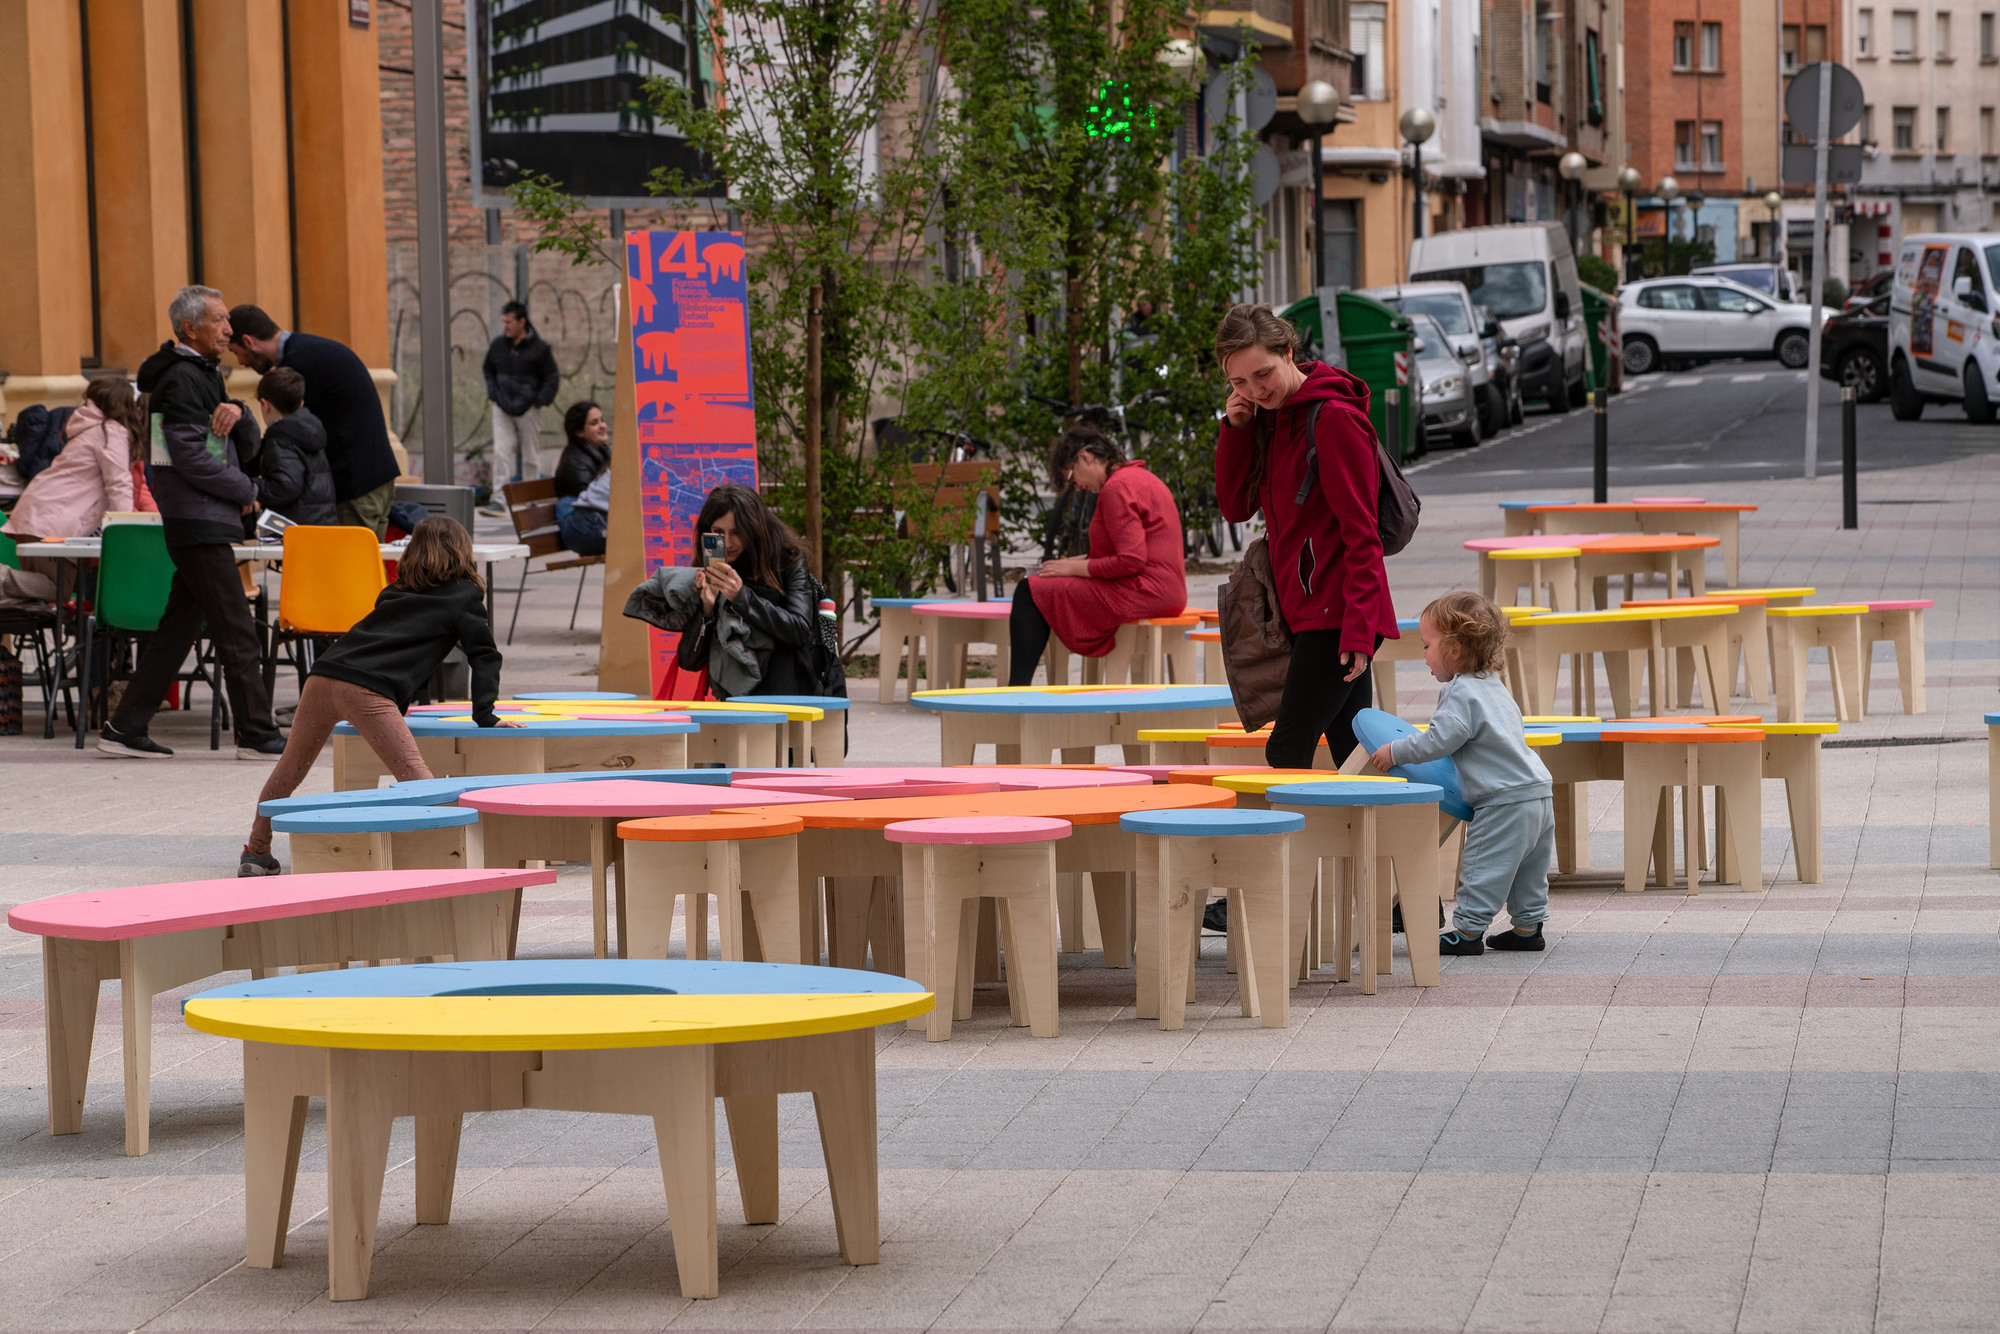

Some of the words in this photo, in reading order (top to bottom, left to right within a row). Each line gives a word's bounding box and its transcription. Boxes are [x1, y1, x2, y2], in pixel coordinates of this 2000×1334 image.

[626, 231, 707, 285] 14
[672, 278, 707, 287] Formas
[679, 304, 725, 313] Biblioteca
[679, 312, 709, 320] Rafael
[680, 319, 715, 328] Azcona
